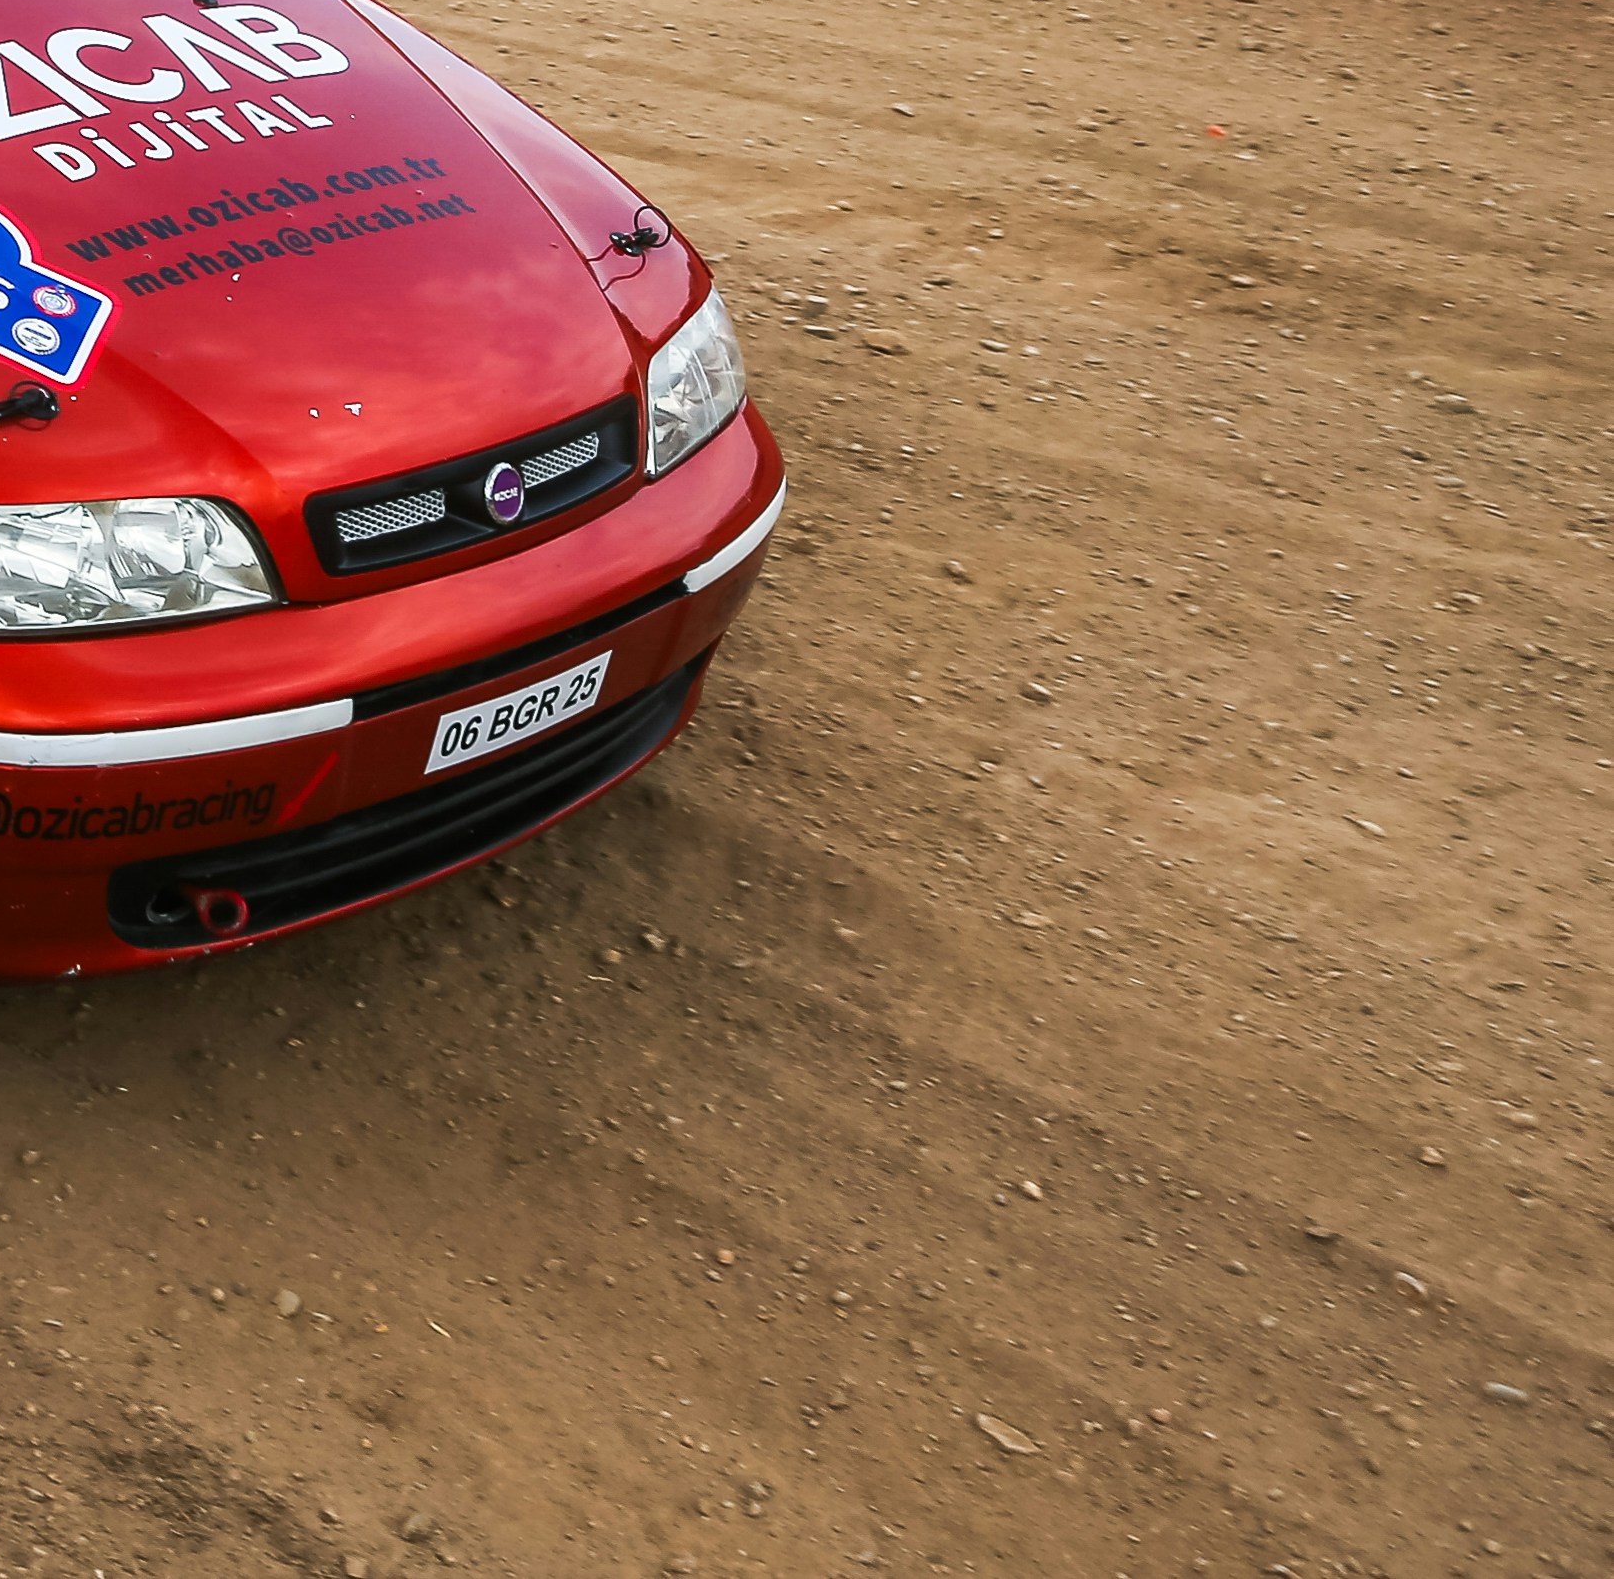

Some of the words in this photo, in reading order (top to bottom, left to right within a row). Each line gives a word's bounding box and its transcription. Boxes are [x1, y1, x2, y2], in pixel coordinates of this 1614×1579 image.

[65, 156, 447, 263] www.ozicab.com.tr
[122, 192, 476, 296] merhaba@ozicab.net
[440, 716, 482, 757] 06
[487, 685, 560, 742] BGR
[562, 665, 601, 711] 25
